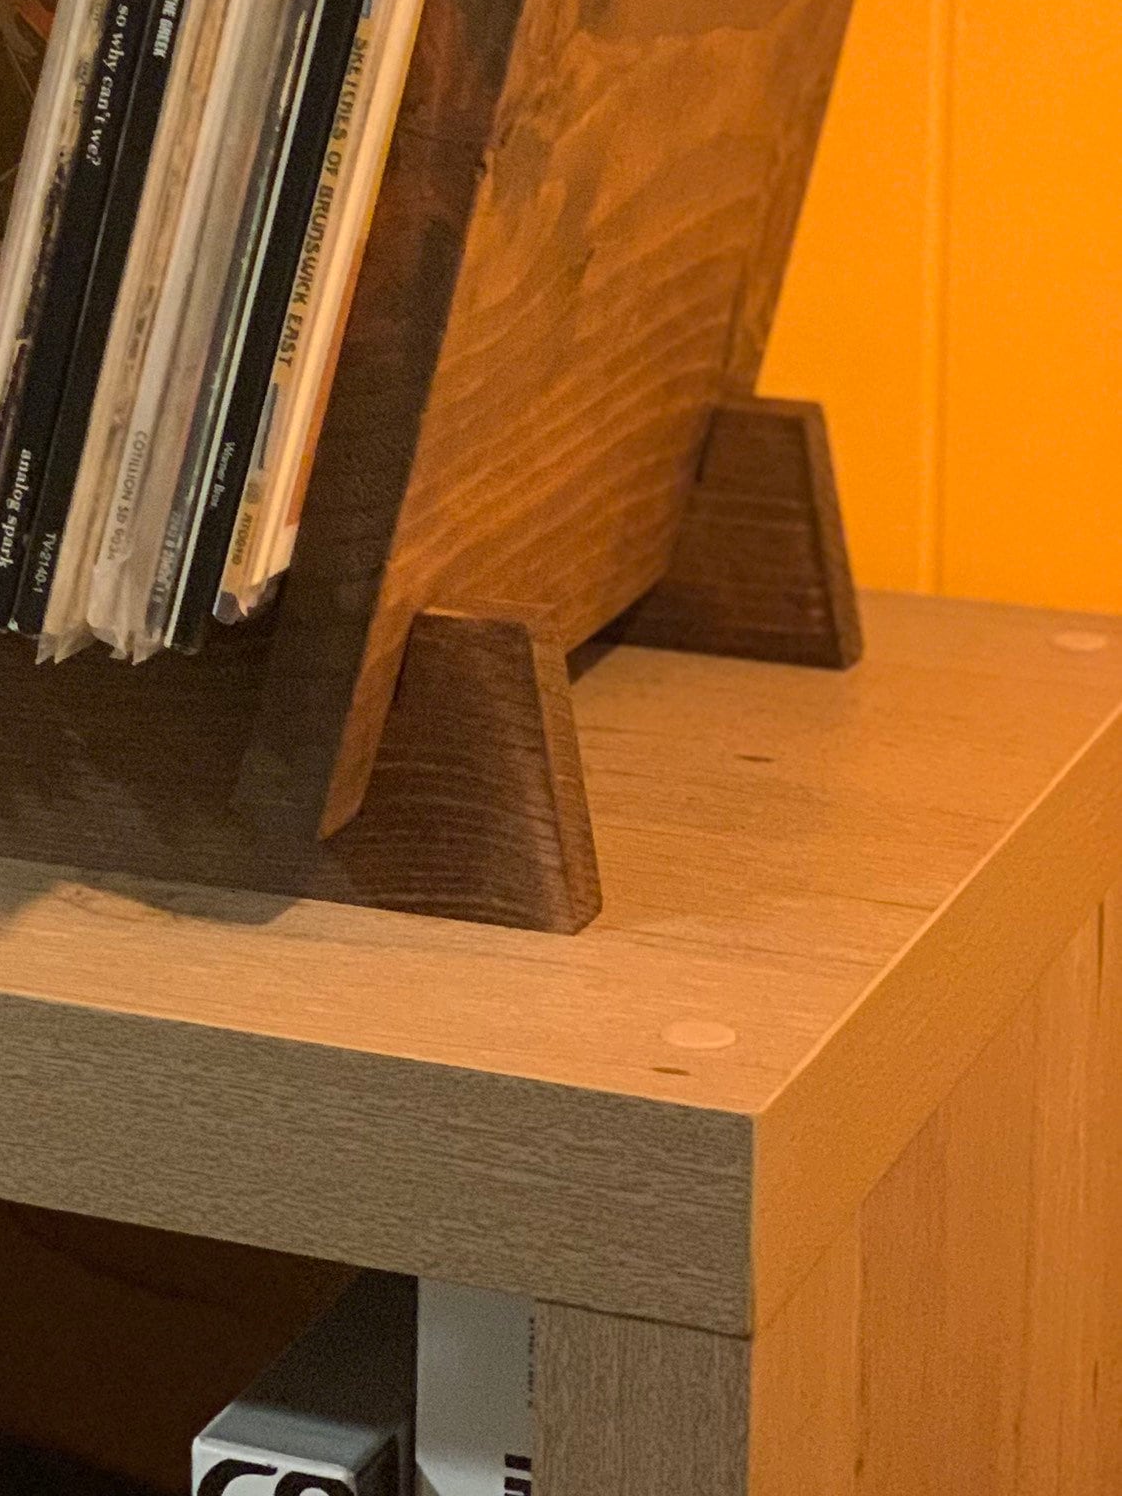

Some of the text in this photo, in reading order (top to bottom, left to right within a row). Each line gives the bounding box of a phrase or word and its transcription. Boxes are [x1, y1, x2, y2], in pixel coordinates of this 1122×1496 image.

[115, 4, 131, 28] so
[101, 30, 128, 73] why
[152, 18, 173, 58] GREEK
[93, 75, 119, 125] can't
[83, 126, 107, 166] we?
[276, 37, 369, 368] SKETCHES OF BRUNSWICK EAST
[5, 447, 36, 512] analog
[119, 429, 147, 502] COTILLION
[215, 440, 235, 482] Warner
[114, 505, 130, 524] SD
[31, 531, 56, 594] TV-2140-1
